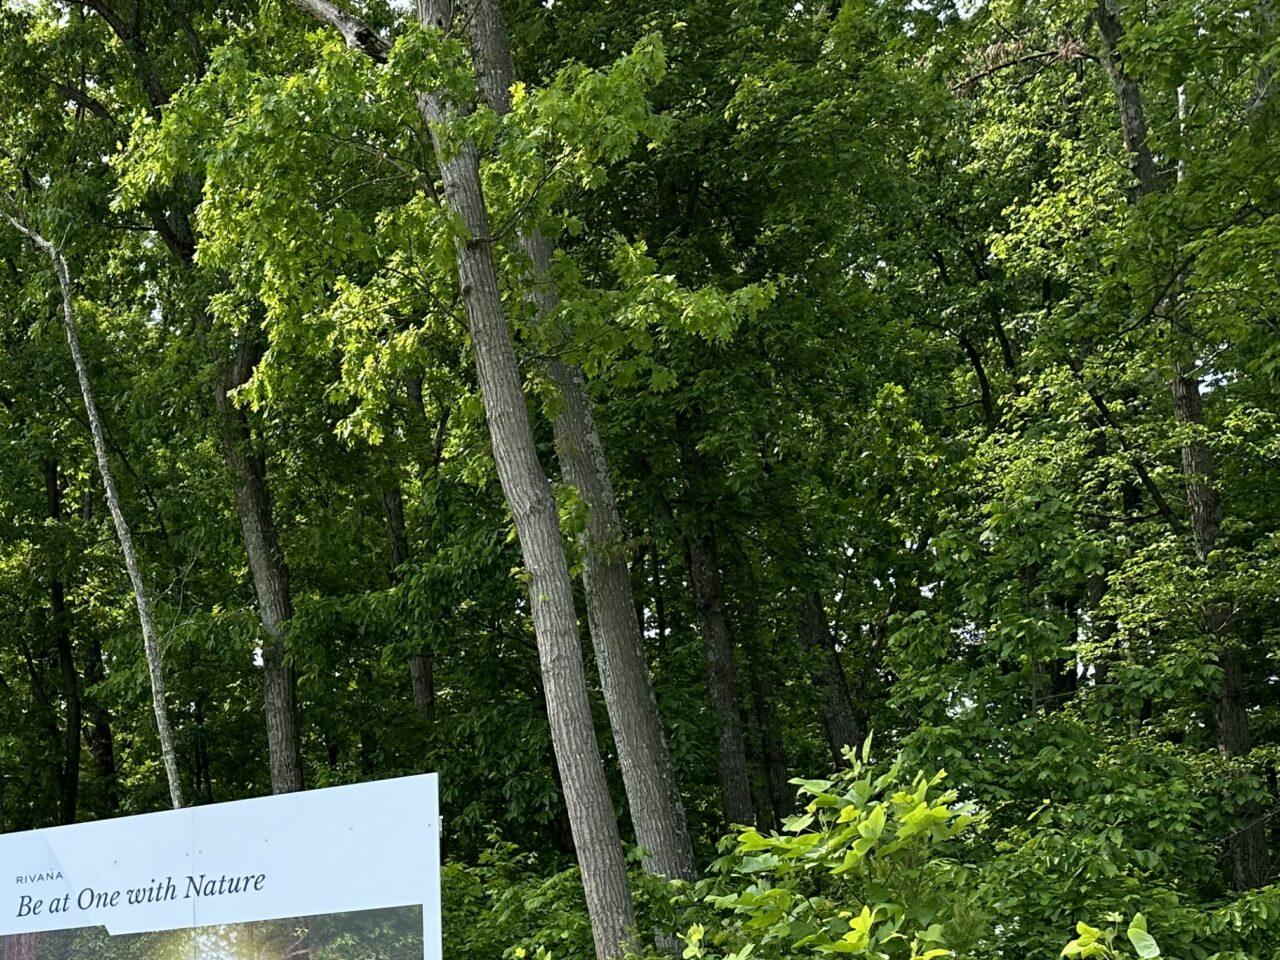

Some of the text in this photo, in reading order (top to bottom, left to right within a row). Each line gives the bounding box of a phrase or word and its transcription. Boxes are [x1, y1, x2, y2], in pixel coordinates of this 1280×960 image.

[16, 871, 64, 885] RIVANA
[15, 873, 266, 918] Be at One with Nature
